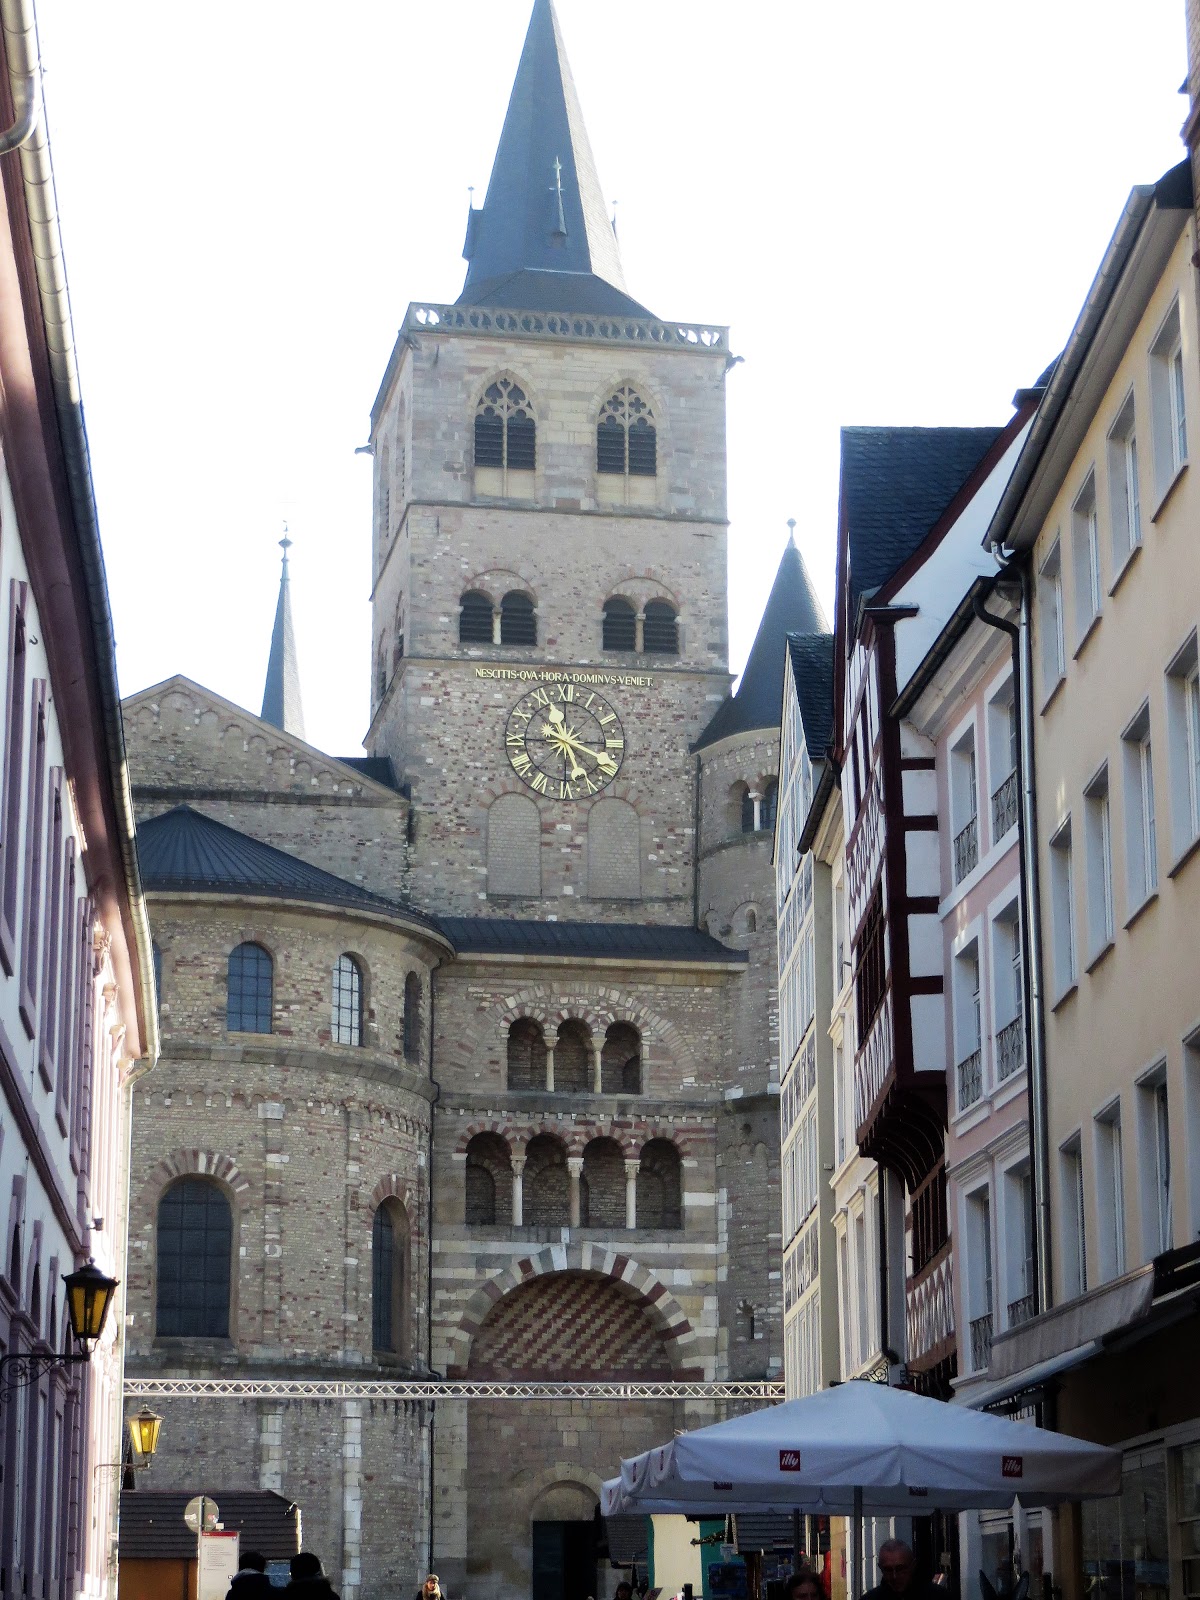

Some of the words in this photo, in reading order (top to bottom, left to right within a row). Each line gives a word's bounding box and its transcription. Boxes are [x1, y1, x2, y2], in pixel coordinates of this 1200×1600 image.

[475, 668, 517, 679] NESCITIS
[520, 670, 538, 681] QVA
[541, 671, 570, 682] HORA
[573, 673, 617, 685] DOMINVS
[557, 684, 574, 702] XII
[512, 707, 532, 722] X
[781, 1453, 799, 1468] illy
[1004, 1460, 1021, 1474] illy
